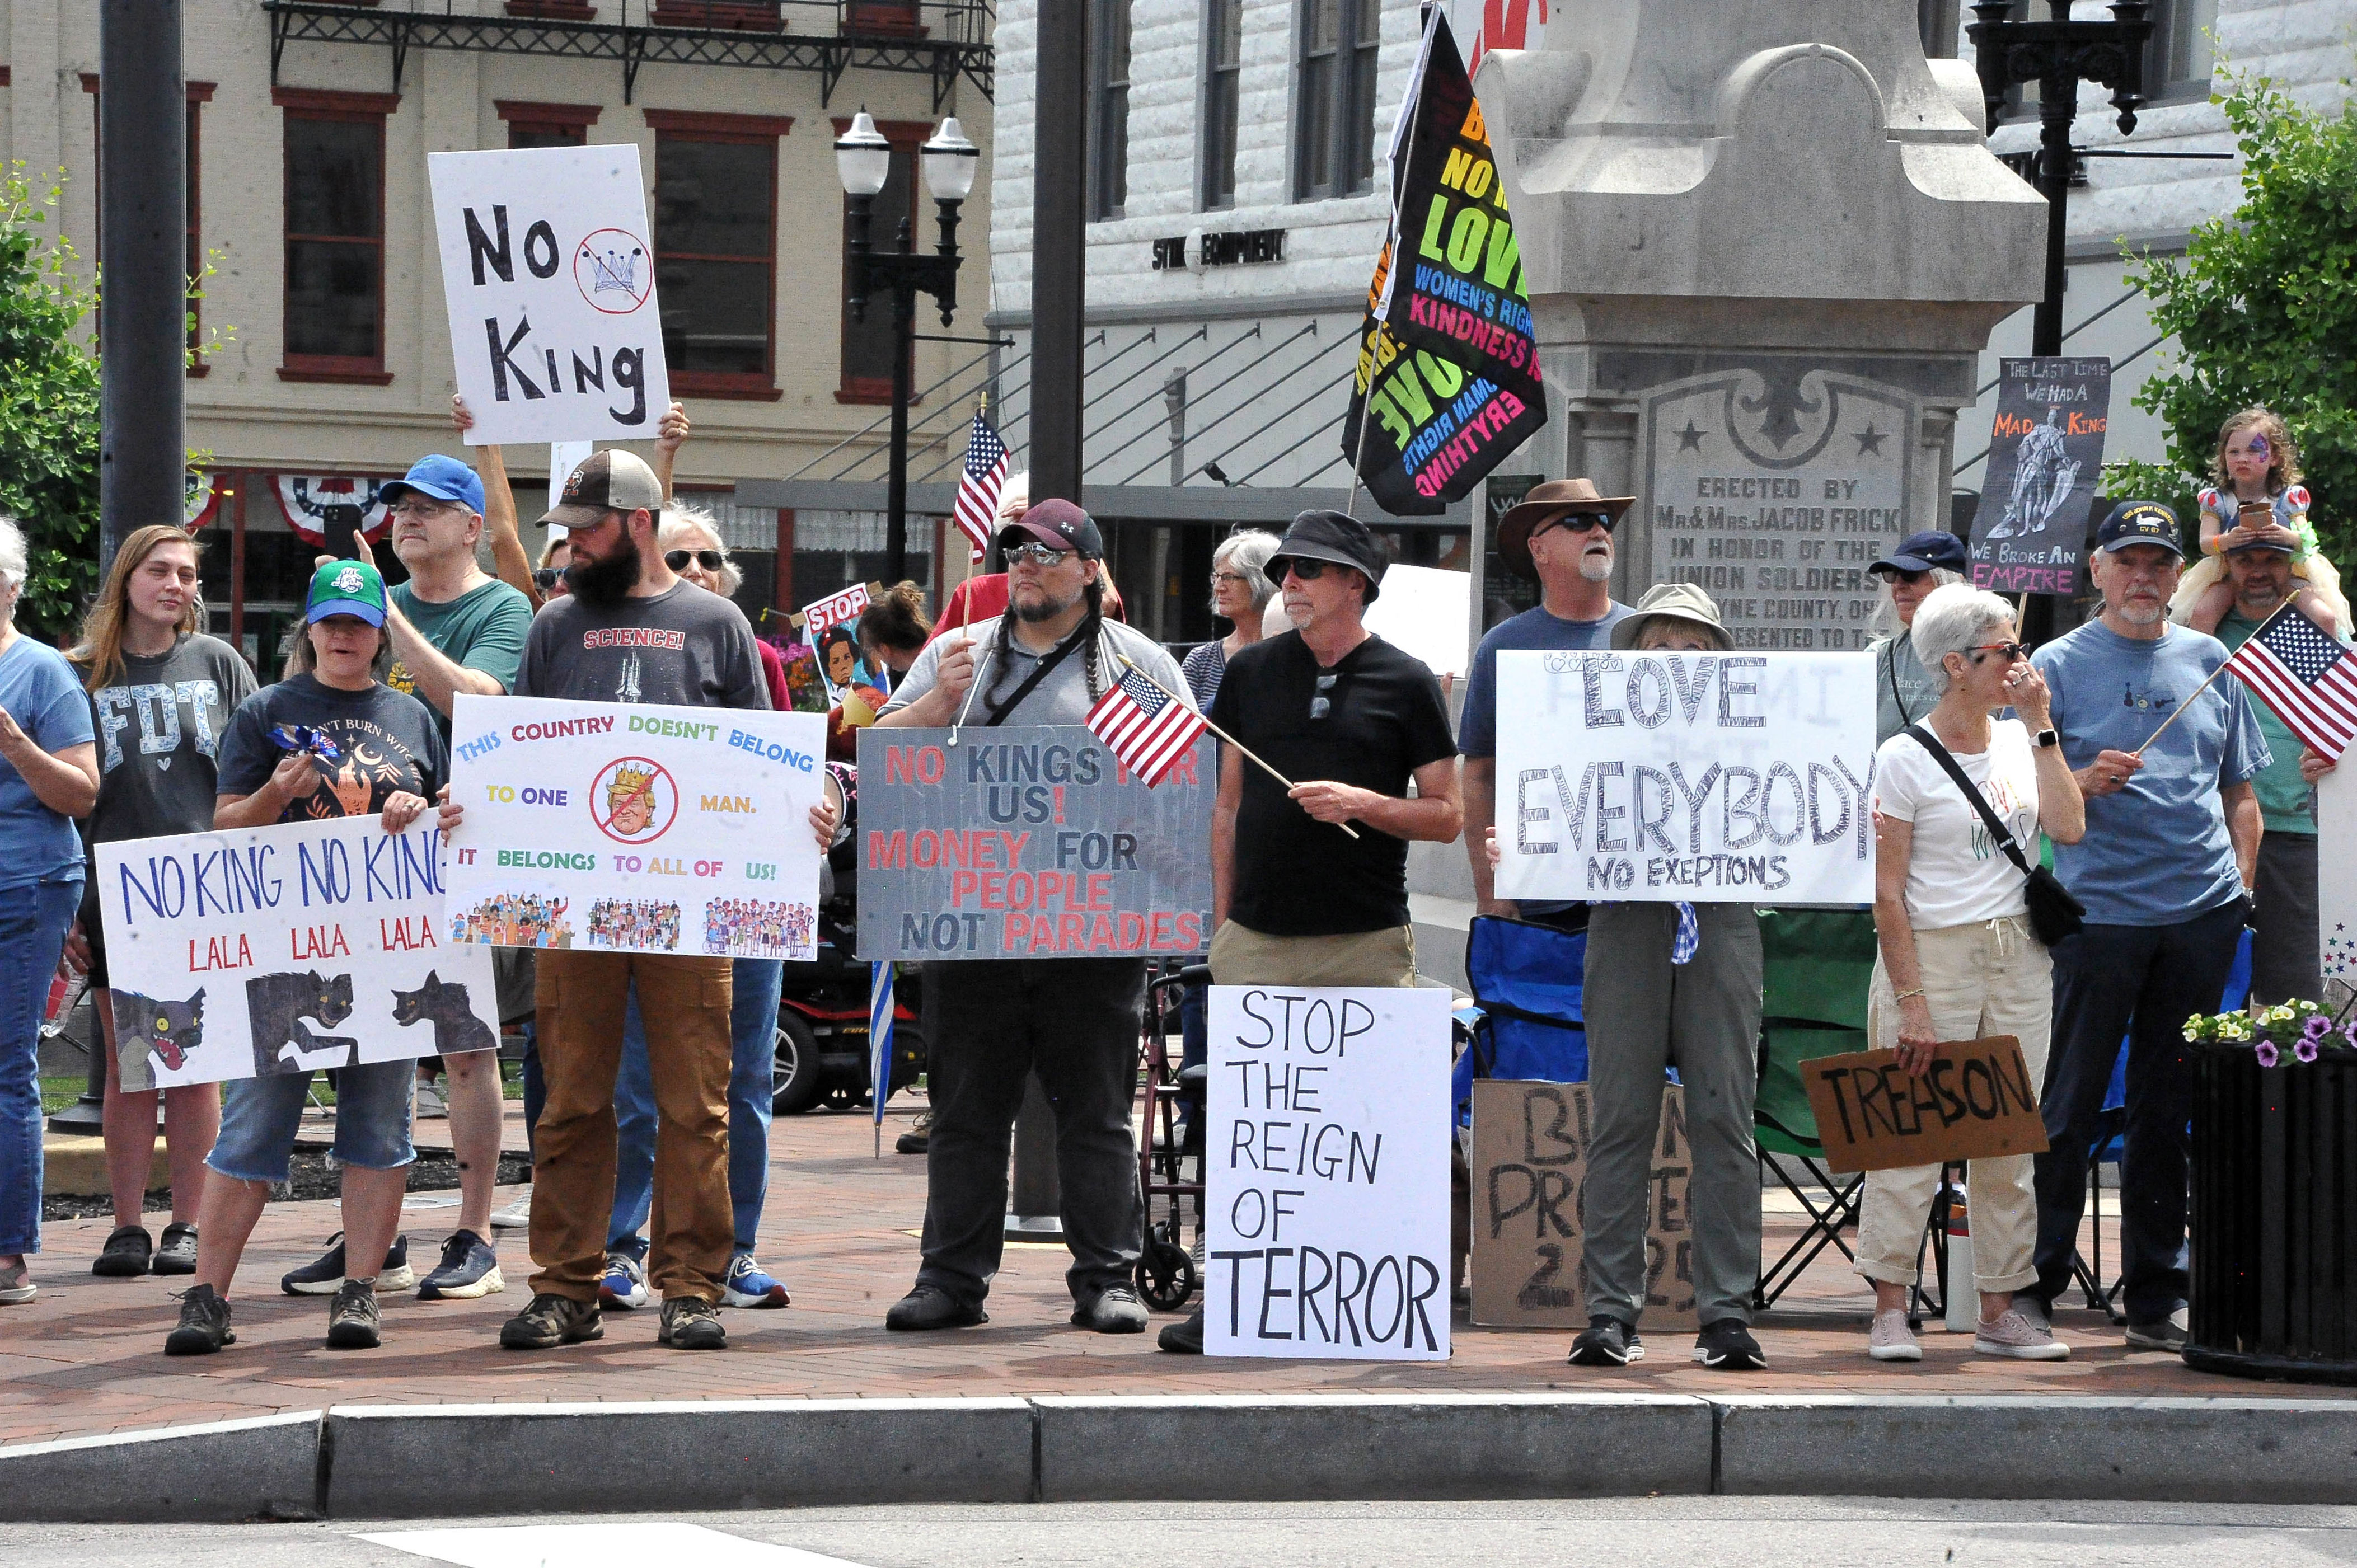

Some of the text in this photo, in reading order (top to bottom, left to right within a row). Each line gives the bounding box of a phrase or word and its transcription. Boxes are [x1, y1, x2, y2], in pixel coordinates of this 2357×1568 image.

[1440, 147, 1493, 198] NO
[1419, 193, 1529, 301] LOV
[1414, 263, 1496, 318] WOMEN'S
[1499, 298, 1535, 339] RIGH
[1409, 293, 1527, 368] KINDNESS
[2005, 360, 2107, 379] THE LAST TIME
[2025, 383, 2088, 403] WE HAD A
[1697, 477, 1858, 500] ERECTED BY
[1752, 507, 1824, 531] JACOB
[1830, 507, 1902, 532] FRICK
[2122, 510, 2134, 520] USS
[2134, 506, 2149, 514] JOHN
[2154, 506, 2175, 525] KENNEDY
[1671, 537, 1881, 560] IN HONOR OF THE
[1970, 542, 2075, 565] WE BROKE AN
[1671, 565, 1880, 592] UNION SOLDIERS
[1972, 564, 2073, 594] EMPIRE
[809, 590, 865, 631] STOP
[584, 627, 686, 651] SCIENCE!
[1728, 626, 1814, 648] ESENTED
[1821, 628, 1845, 648] TO
[1582, 654, 1768, 730] LOVE
[93, 680, 218, 774] FDT
[318, 720, 340, 735] N'T
[345, 719, 382, 737] BURN
[456, 715, 814, 773] THIS COUNTRY DOESN'T BELONG
[886, 745, 945, 785] NO
[967, 745, 1102, 785] KINGS
[487, 785, 757, 813] TO ONE MAN.
[988, 786, 1065, 824] US!
[1517, 751, 1876, 861] EVERYBODY
[458, 848, 776, 880] IT BELONGS TO ALL OF US!
[868, 830, 1138, 870] MONEY FOR
[120, 855, 185, 924] NO
[193, 844, 282, 917] KING
[299, 838, 350, 907] NO
[952, 870, 1112, 912] PEOPLE
[1588, 855, 1791, 891] NO EXEPTIONS
[189, 914, 437, 972] LALA LALA LALA
[901, 912, 986, 951] NOT
[1236, 990, 1374, 1057] STOP
[1226, 1060, 1328, 1113] THE
[1821, 1049, 2032, 1144] TREASON
[1231, 1120, 1382, 1185] REIGN
[1231, 1188, 1305, 1242] OF
[1210, 1246, 1440, 1352] TERROR
